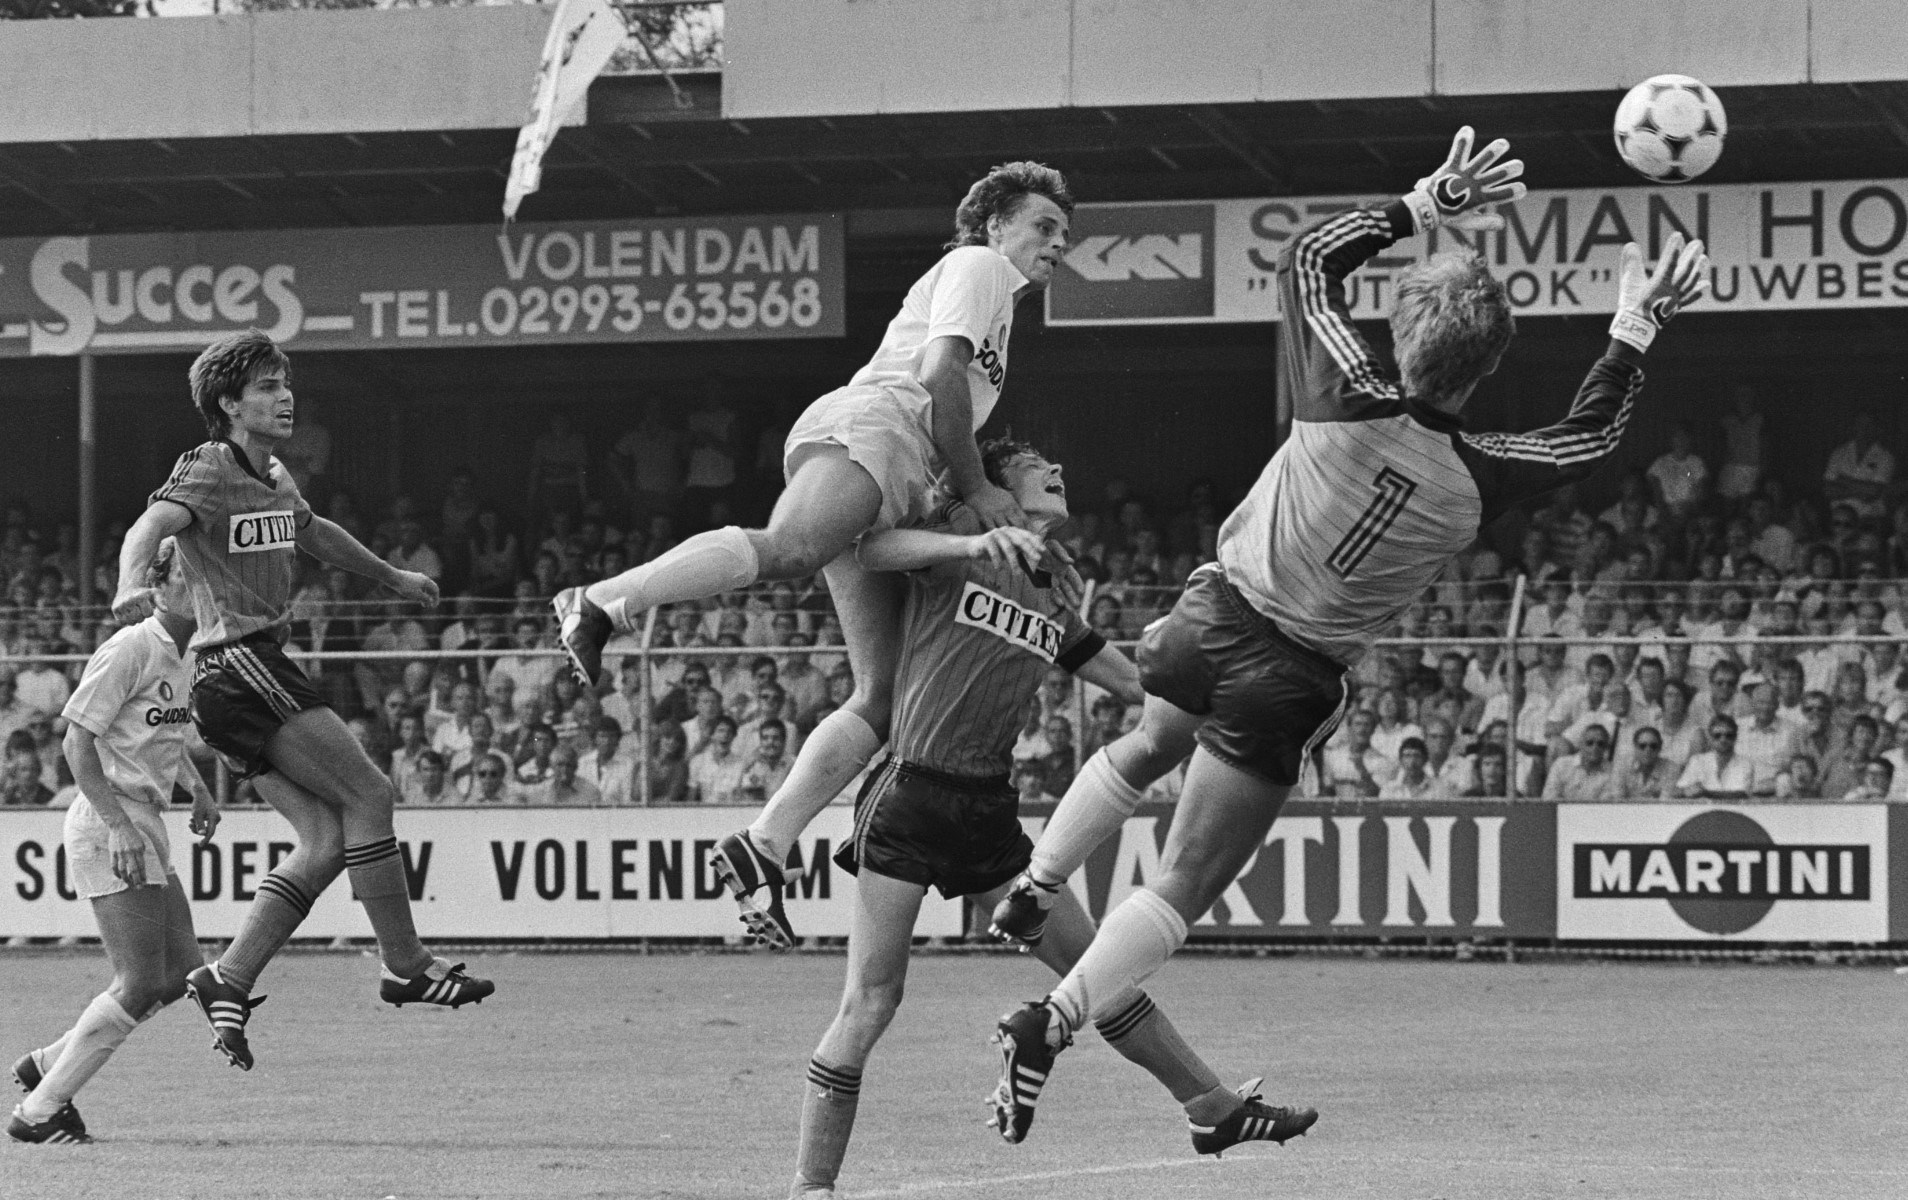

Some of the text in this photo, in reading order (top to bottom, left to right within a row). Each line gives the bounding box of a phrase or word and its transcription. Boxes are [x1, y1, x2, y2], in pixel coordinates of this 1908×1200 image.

[497, 226, 819, 280] VOLENDAM
[1324, 465, 1418, 580] 1
[490, 838, 831, 901] VOLENDM
[1590, 849, 1854, 894] MARTINI
